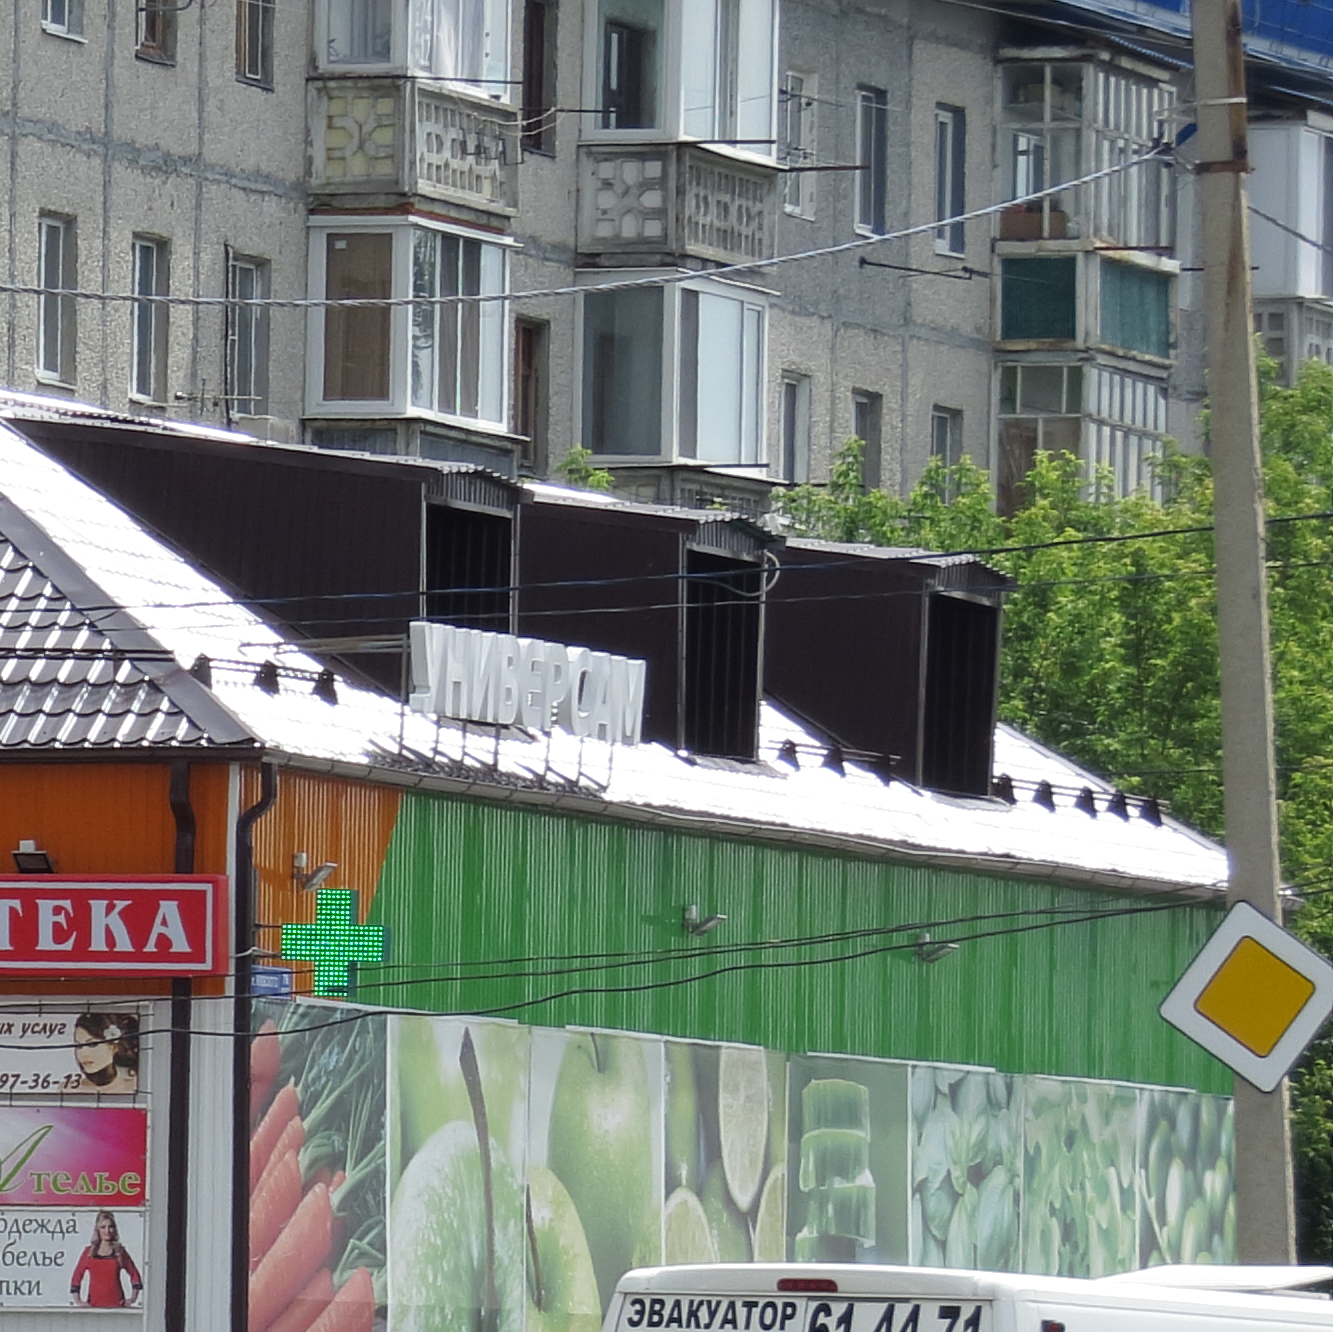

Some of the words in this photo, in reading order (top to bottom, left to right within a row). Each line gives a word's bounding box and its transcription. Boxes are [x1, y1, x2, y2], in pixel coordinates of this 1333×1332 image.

[19, 1022, 66, 1038] услуг
[2, 1239, 65, 1266] белье
[626, 1298, 797, 1331] ЭВАКУАТОР
